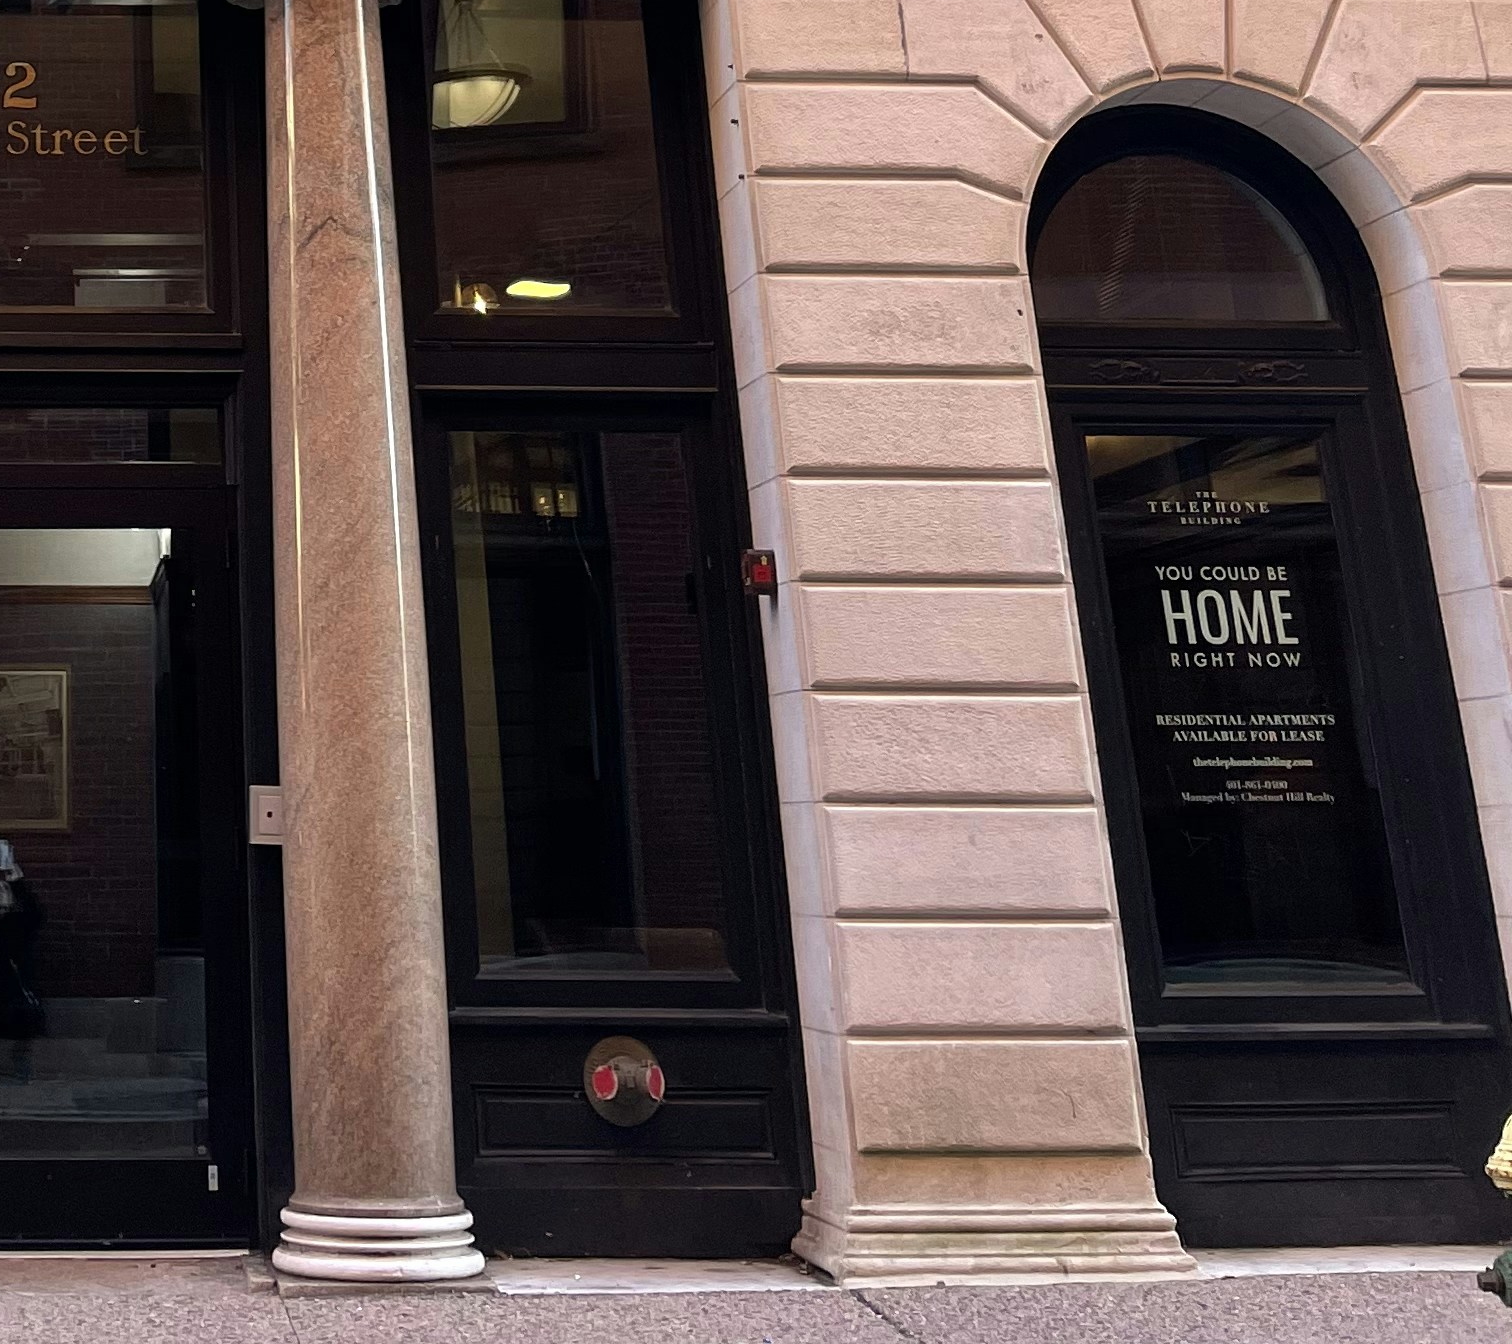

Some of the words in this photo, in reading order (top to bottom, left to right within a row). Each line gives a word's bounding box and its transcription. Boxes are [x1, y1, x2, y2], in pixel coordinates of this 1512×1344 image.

[5, 119, 149, 156] Street
[1195, 491, 1218, 499] THE
[1146, 501, 1270, 514] TELEPHONE
[1180, 516, 1242, 525] BUILDING
[1154, 565, 1193, 581] YOU
[1200, 565, 1260, 581] COULD
[1266, 565, 1288, 581] BE
[1160, 589, 1299, 645] HOME
[1170, 652, 1236, 668] RIGHT
[1247, 652, 1301, 668] NOW
[1156, 714, 1246, 726] RESIDENTIAL
[1248, 714, 1336, 726] APARTMENTS
[1172, 730, 1248, 742] AVAILABLE
[1250, 730, 1278, 742] FOR
[1280, 730, 1326, 742] LEASE
